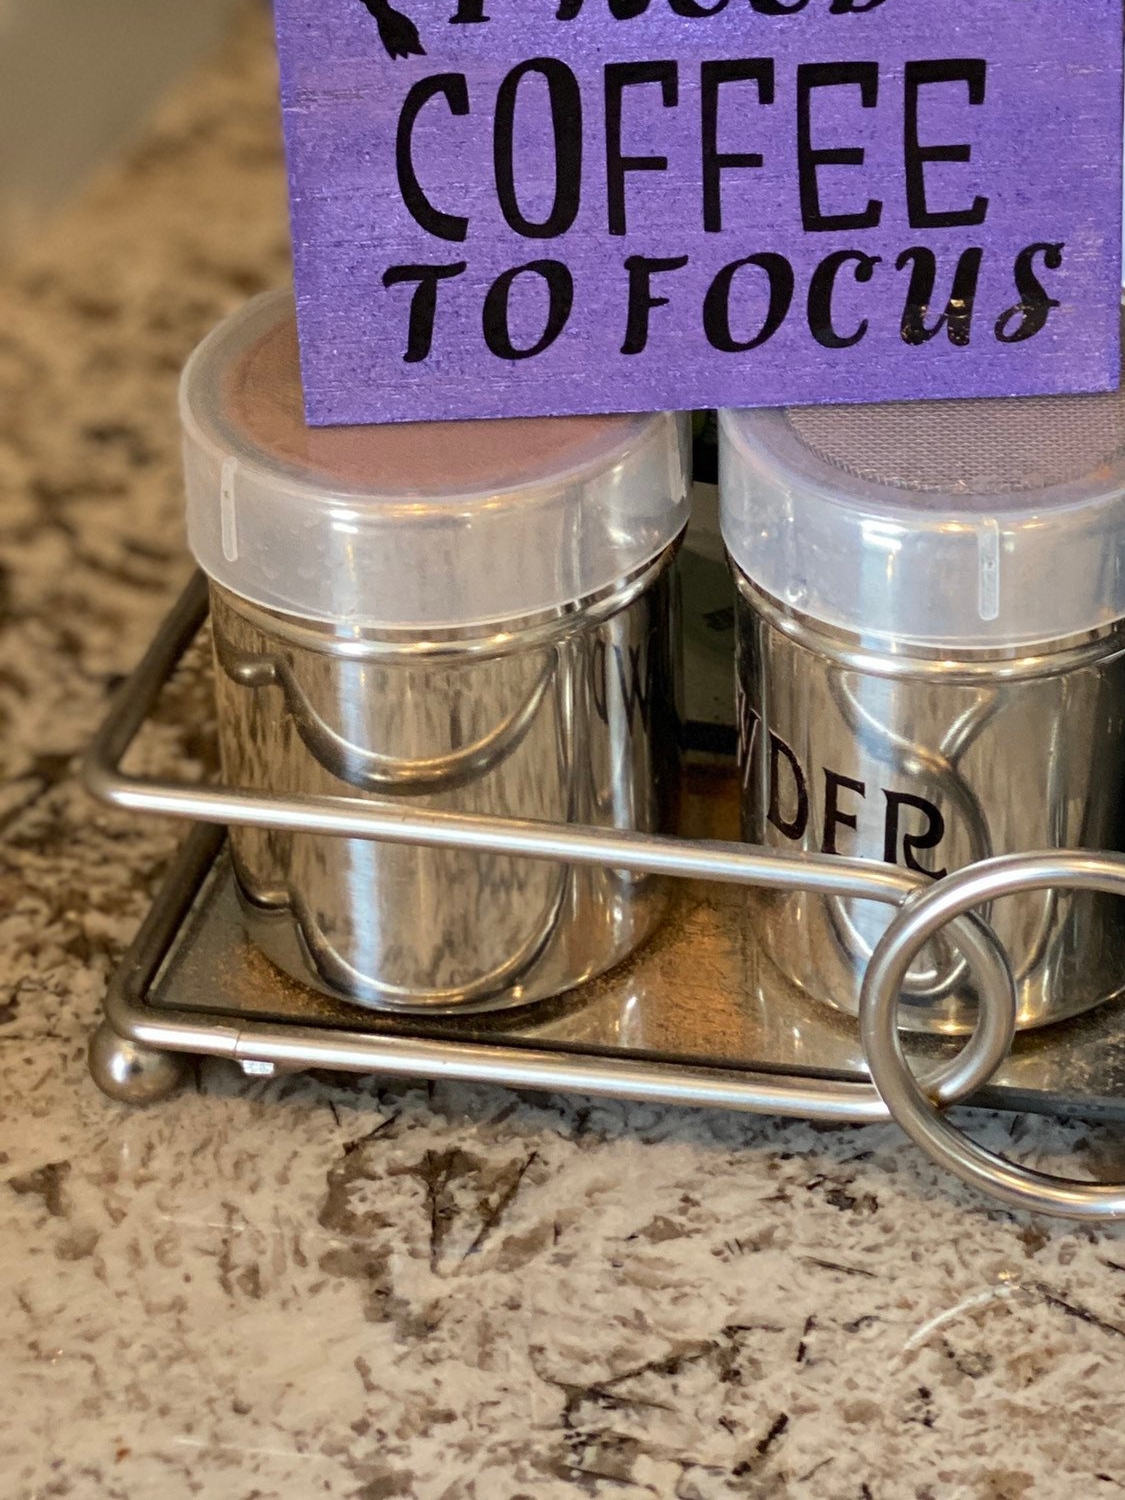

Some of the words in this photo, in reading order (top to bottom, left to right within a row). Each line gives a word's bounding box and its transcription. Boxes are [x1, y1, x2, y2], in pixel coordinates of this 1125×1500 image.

[396, 58, 988, 242] COFFEE
[383, 260, 573, 362] TO
[621, 243, 1064, 354] FOCUS
